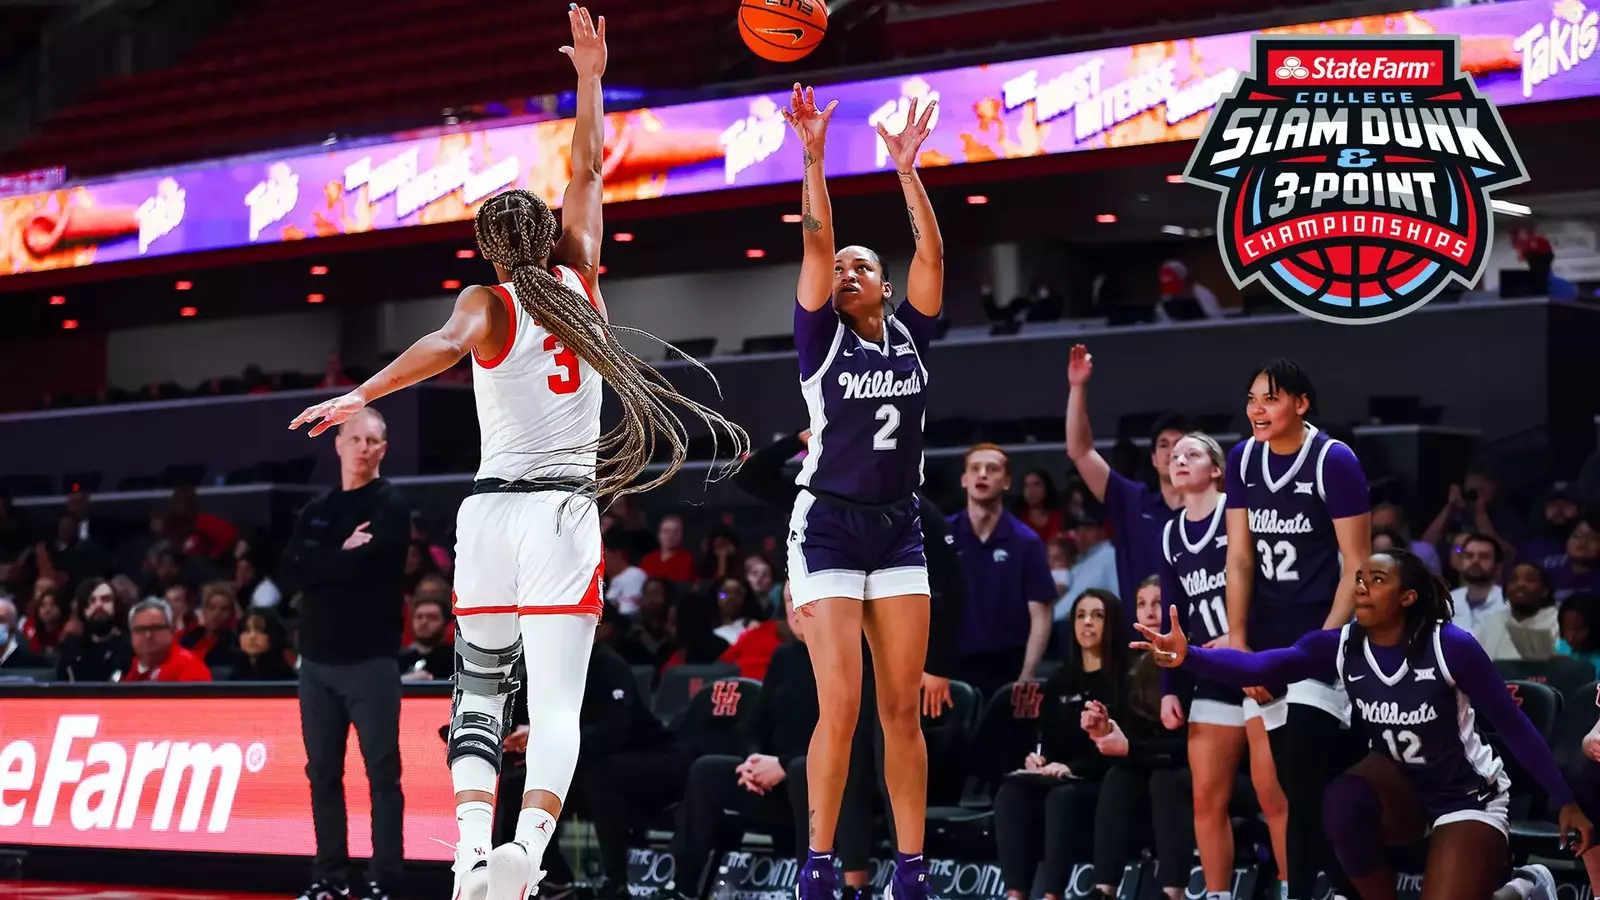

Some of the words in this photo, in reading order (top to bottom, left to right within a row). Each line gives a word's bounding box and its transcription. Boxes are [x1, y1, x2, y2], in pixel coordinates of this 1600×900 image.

[543, 333, 582, 396] 3
[838, 369, 921, 399] Wildcats
[873, 404, 901, 451] 2
[1248, 508, 1314, 534] Wildcats
[1256, 539, 1300, 582] 32
[1199, 595, 1230, 638] 11
[1356, 698, 1439, 726] Wildcats
[1382, 729, 1428, 765] 12
